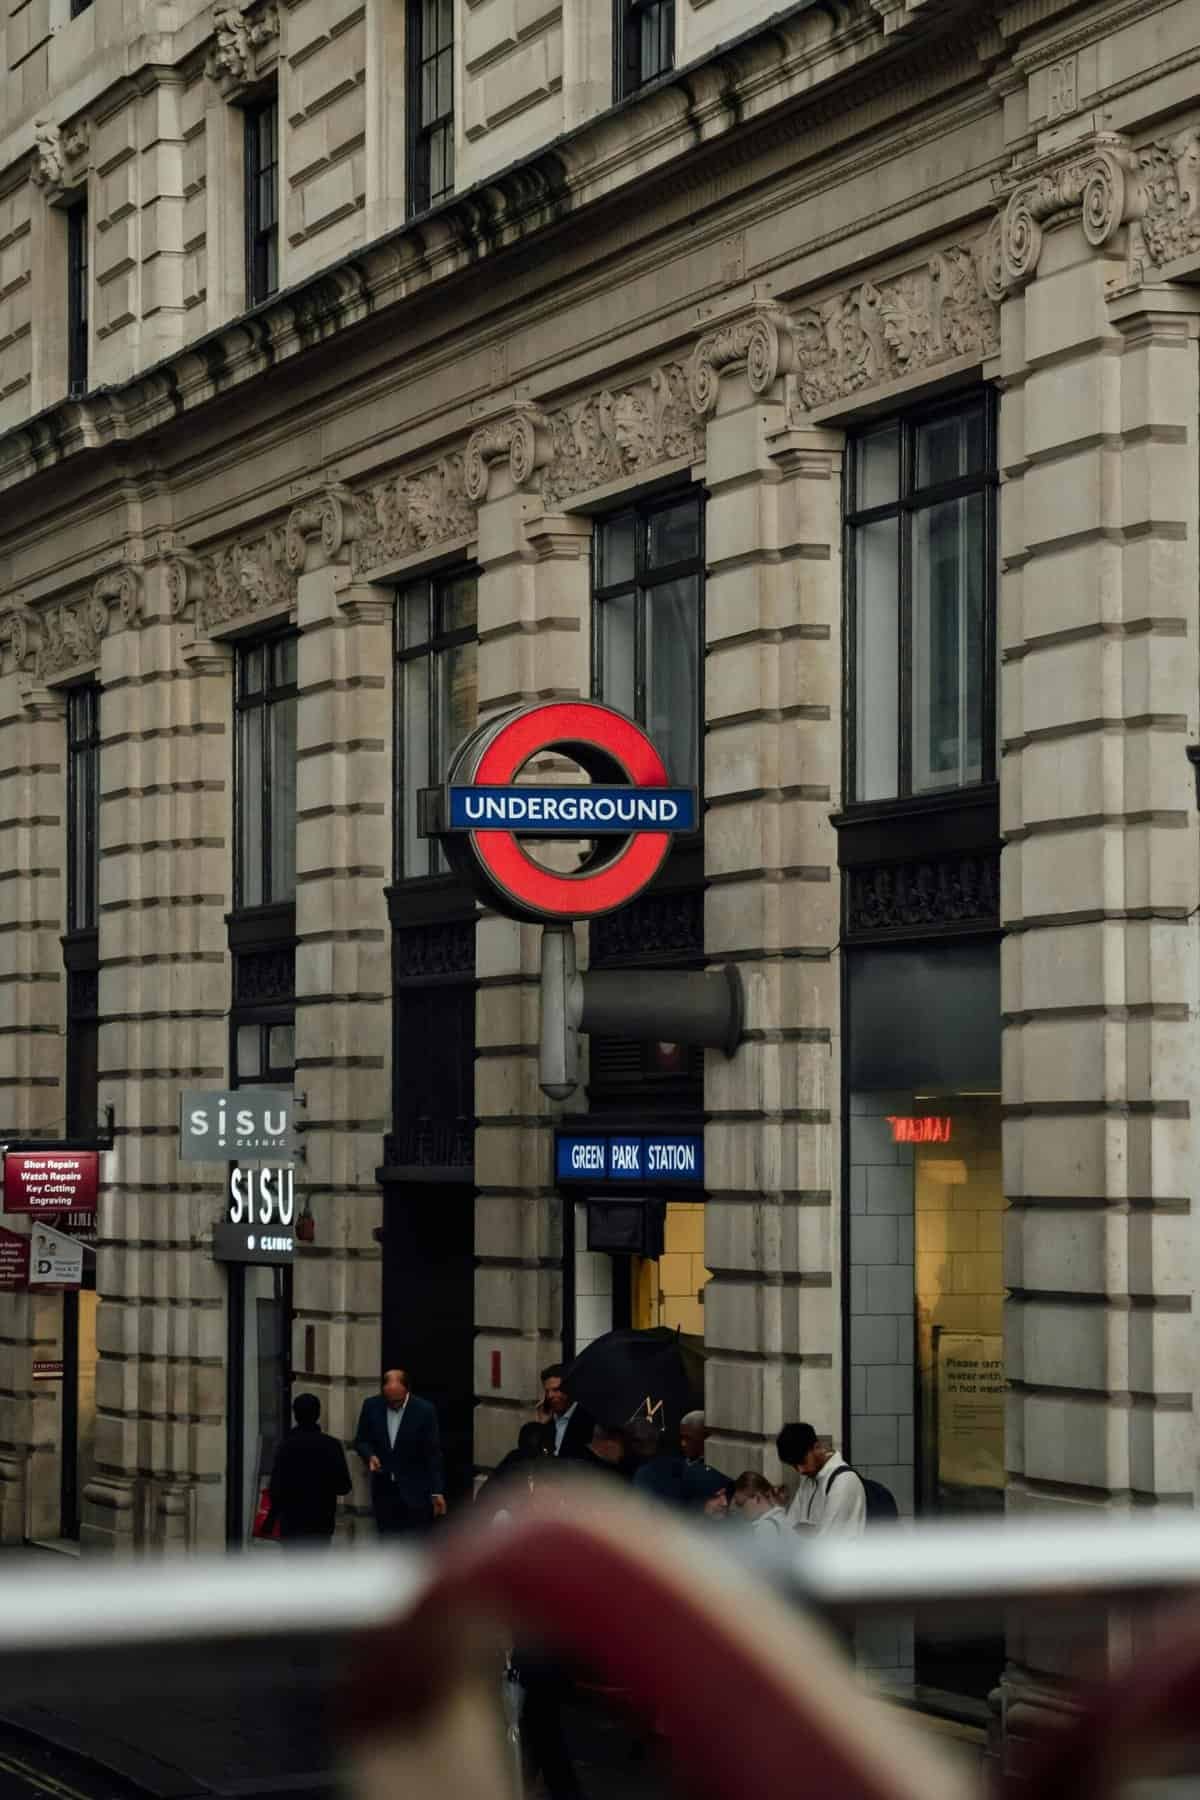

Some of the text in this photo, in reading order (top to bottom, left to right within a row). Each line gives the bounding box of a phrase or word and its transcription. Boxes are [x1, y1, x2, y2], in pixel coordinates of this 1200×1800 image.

[465, 796, 678, 821] UNDERGROUND
[236, 1139, 287, 1147] CLINIC
[571, 1144, 695, 1170] GREEN PARK STATION
[24, 1160, 80, 1170] Shoe Repairs
[21, 1172, 82, 1182] Watch Repairs
[26, 1184, 76, 1194] Key Cutting
[30, 1196, 72, 1206] Engraving
[230, 1167, 294, 1226] SISU
[260, 1237, 294, 1251] CLINIC
